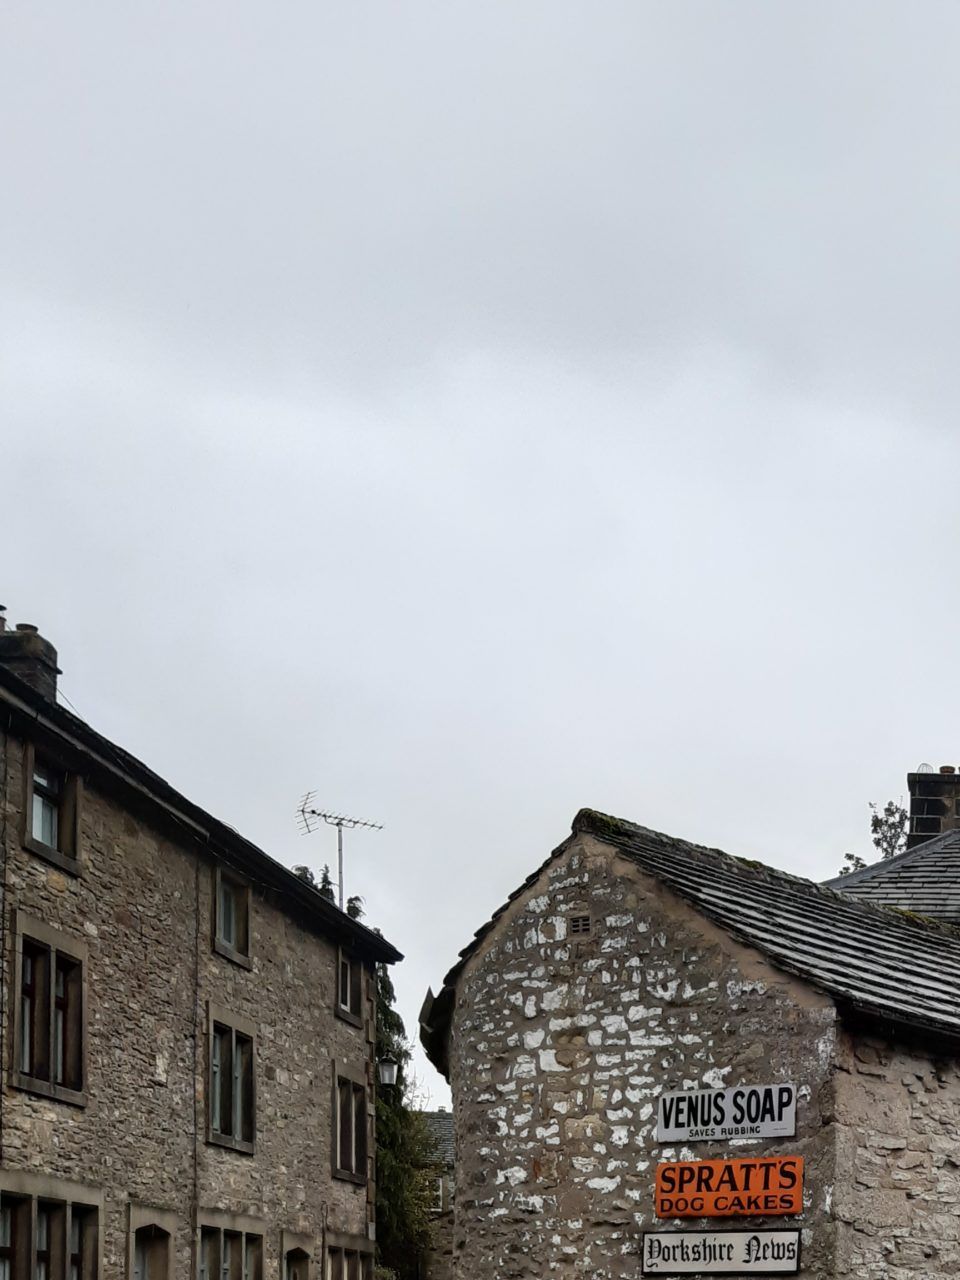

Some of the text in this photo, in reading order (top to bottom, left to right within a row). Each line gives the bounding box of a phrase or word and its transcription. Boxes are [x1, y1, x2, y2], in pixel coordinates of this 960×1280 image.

[662, 1086, 793, 1130] VENUS SOAP
[688, 1125, 761, 1138] SAVES RUBBING
[660, 1160, 798, 1194] SPRATT'S
[660, 1194, 795, 1213] DOG CAKES
[645, 1234, 797, 1268] Yorkshire News
